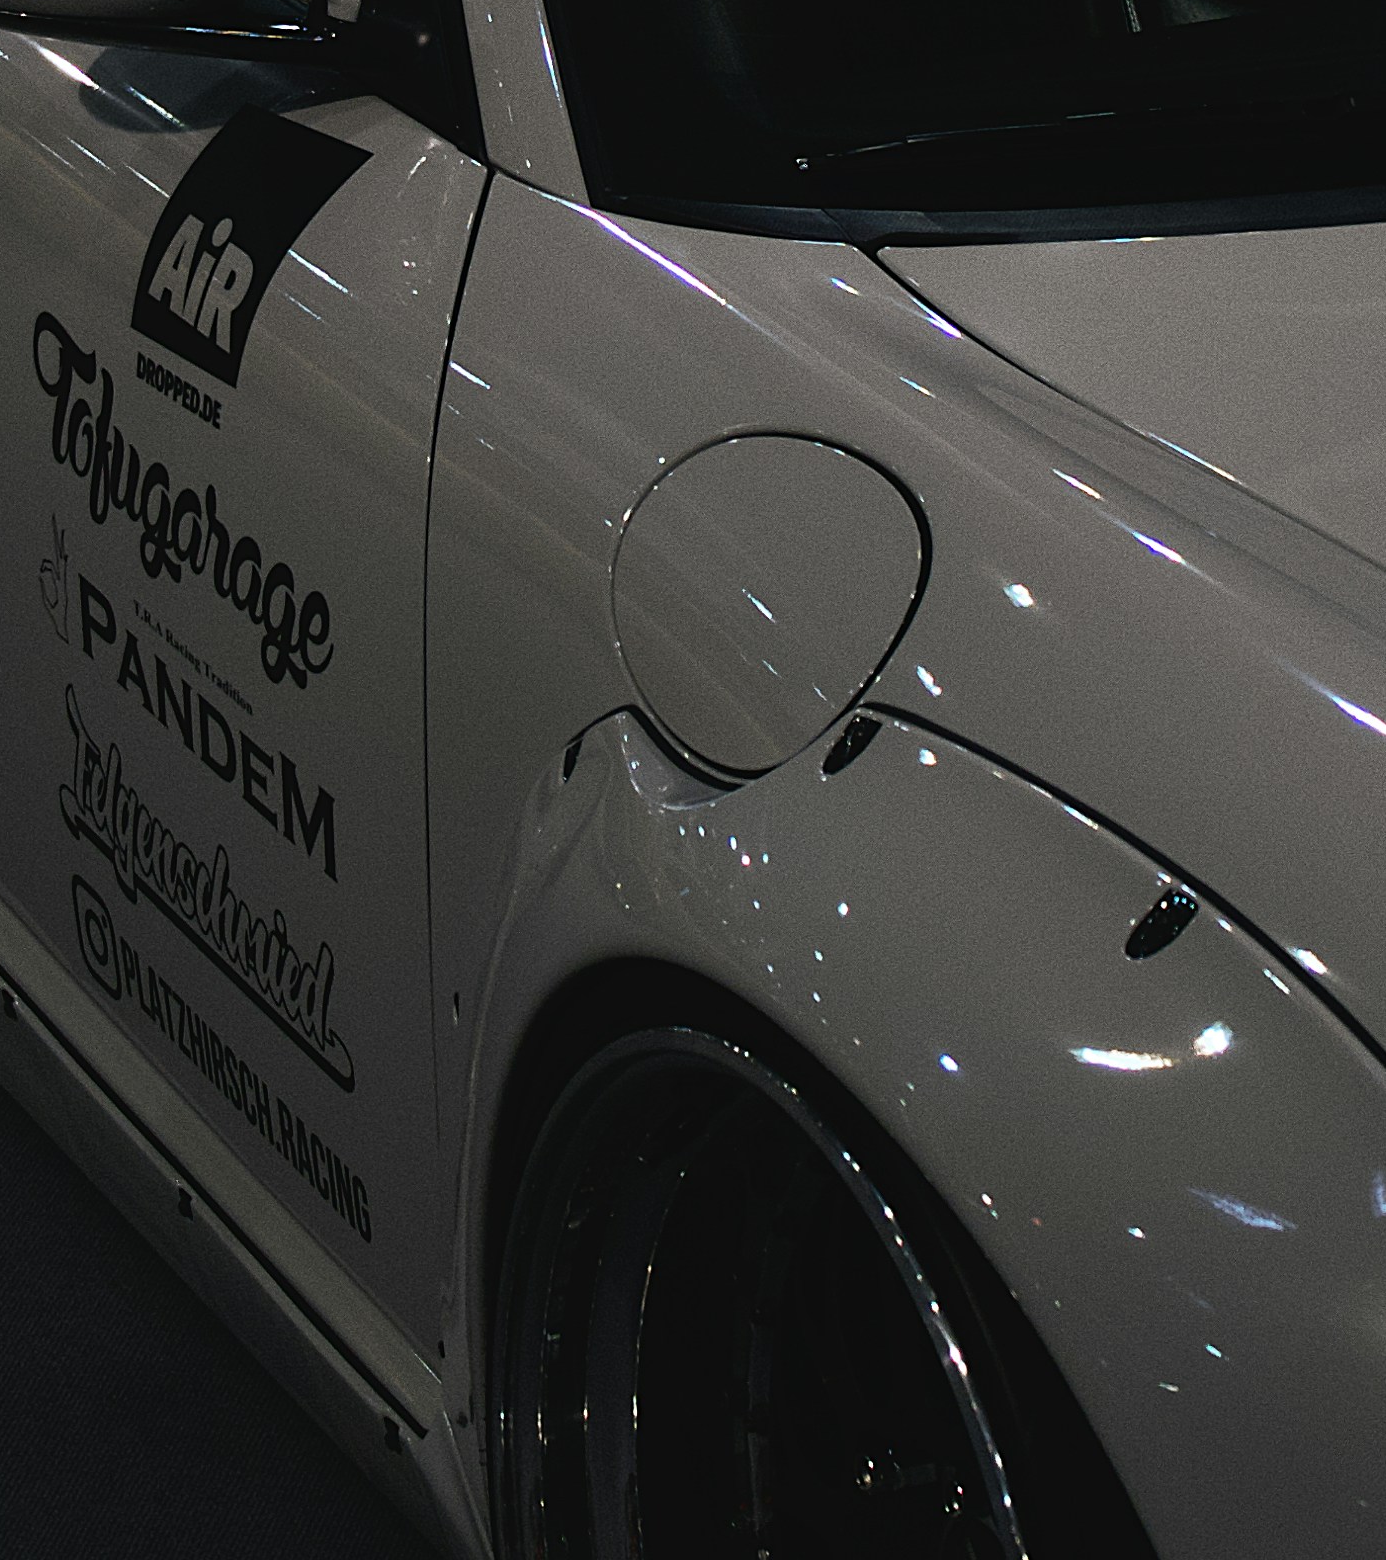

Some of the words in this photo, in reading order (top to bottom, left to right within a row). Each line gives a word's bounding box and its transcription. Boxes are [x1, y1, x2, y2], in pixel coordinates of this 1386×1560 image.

[32, 310, 334, 690] Tofugarage
[136, 351, 222, 430] DROPPED.DE
[78, 572, 339, 883] PANDEM
[165, 629, 201, 674] Racing
[203, 660, 254, 716] Tradition
[120, 935, 373, 1244] PLATZHIRSCH.RACING
